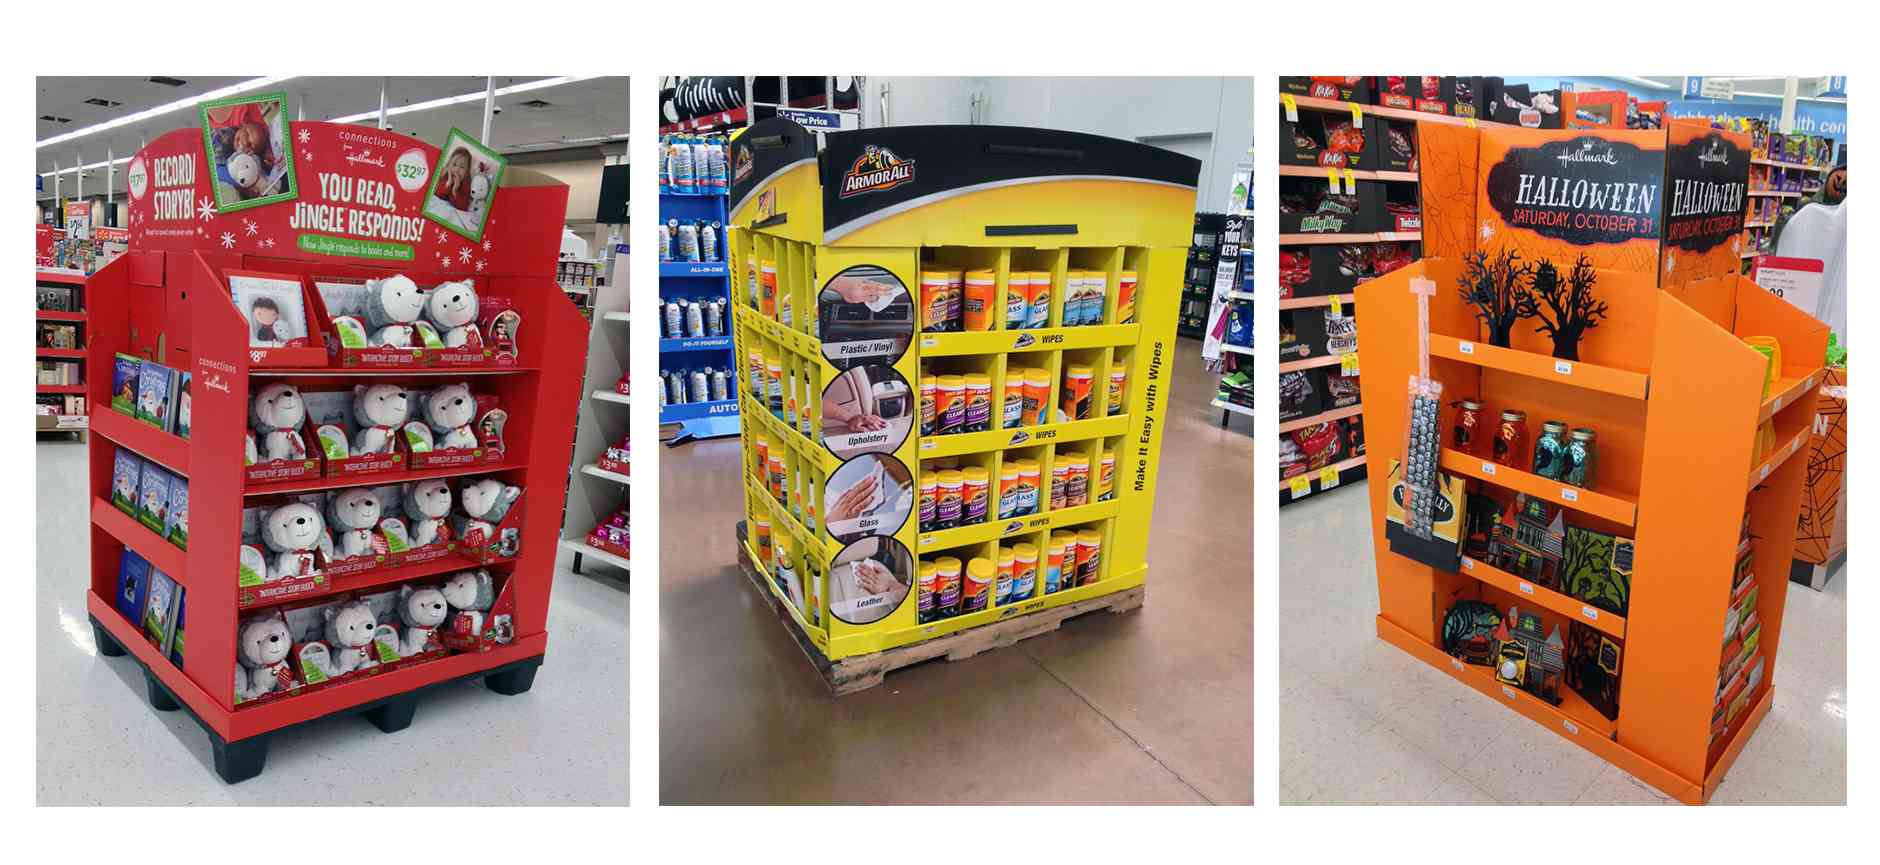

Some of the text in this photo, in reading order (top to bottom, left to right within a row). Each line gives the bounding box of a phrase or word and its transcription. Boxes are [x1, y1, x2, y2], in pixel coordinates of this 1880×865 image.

[1690, 79, 1698, 93] 9
[792, 116, 829, 126] Low Price
[339, 131, 397, 149] connections
[346, 152, 386, 167] Hallmark
[1556, 146, 1618, 168] Hallmark
[1698, 144, 1729, 169] Hallmark
[154, 152, 196, 188] RECORD
[318, 172, 397, 213] YOU READ,
[1515, 174, 1657, 214] HALLOWEEN
[1671, 180, 1744, 216] HALLOWEEN
[1512, 208, 1653, 234] SATURDAY, OCTOBER 31
[1224, 232, 1240, 243] YOUR
[368, 244, 382, 255] books
[383, 246, 394, 256] and
[1222, 244, 1239, 257] KEYS
[1042, 334, 1064, 344] WIPES
[840, 343, 867, 355] Plastic
[874, 342, 894, 353] Vinyl
[198, 357, 237, 375] connections
[1148, 341, 1163, 380] Wipes
[1146, 383, 1157, 412] with
[709, 403, 738, 414] AUTO
[1036, 430, 1057, 440] WIPES
[1140, 415, 1154, 444] Easy
[848, 434, 888, 446] Upholstery
[1134, 458, 1146, 492] Make
[859, 518, 880, 528] Glass
[1030, 519, 1050, 528] WIPES
[857, 596, 884, 608] Leather
